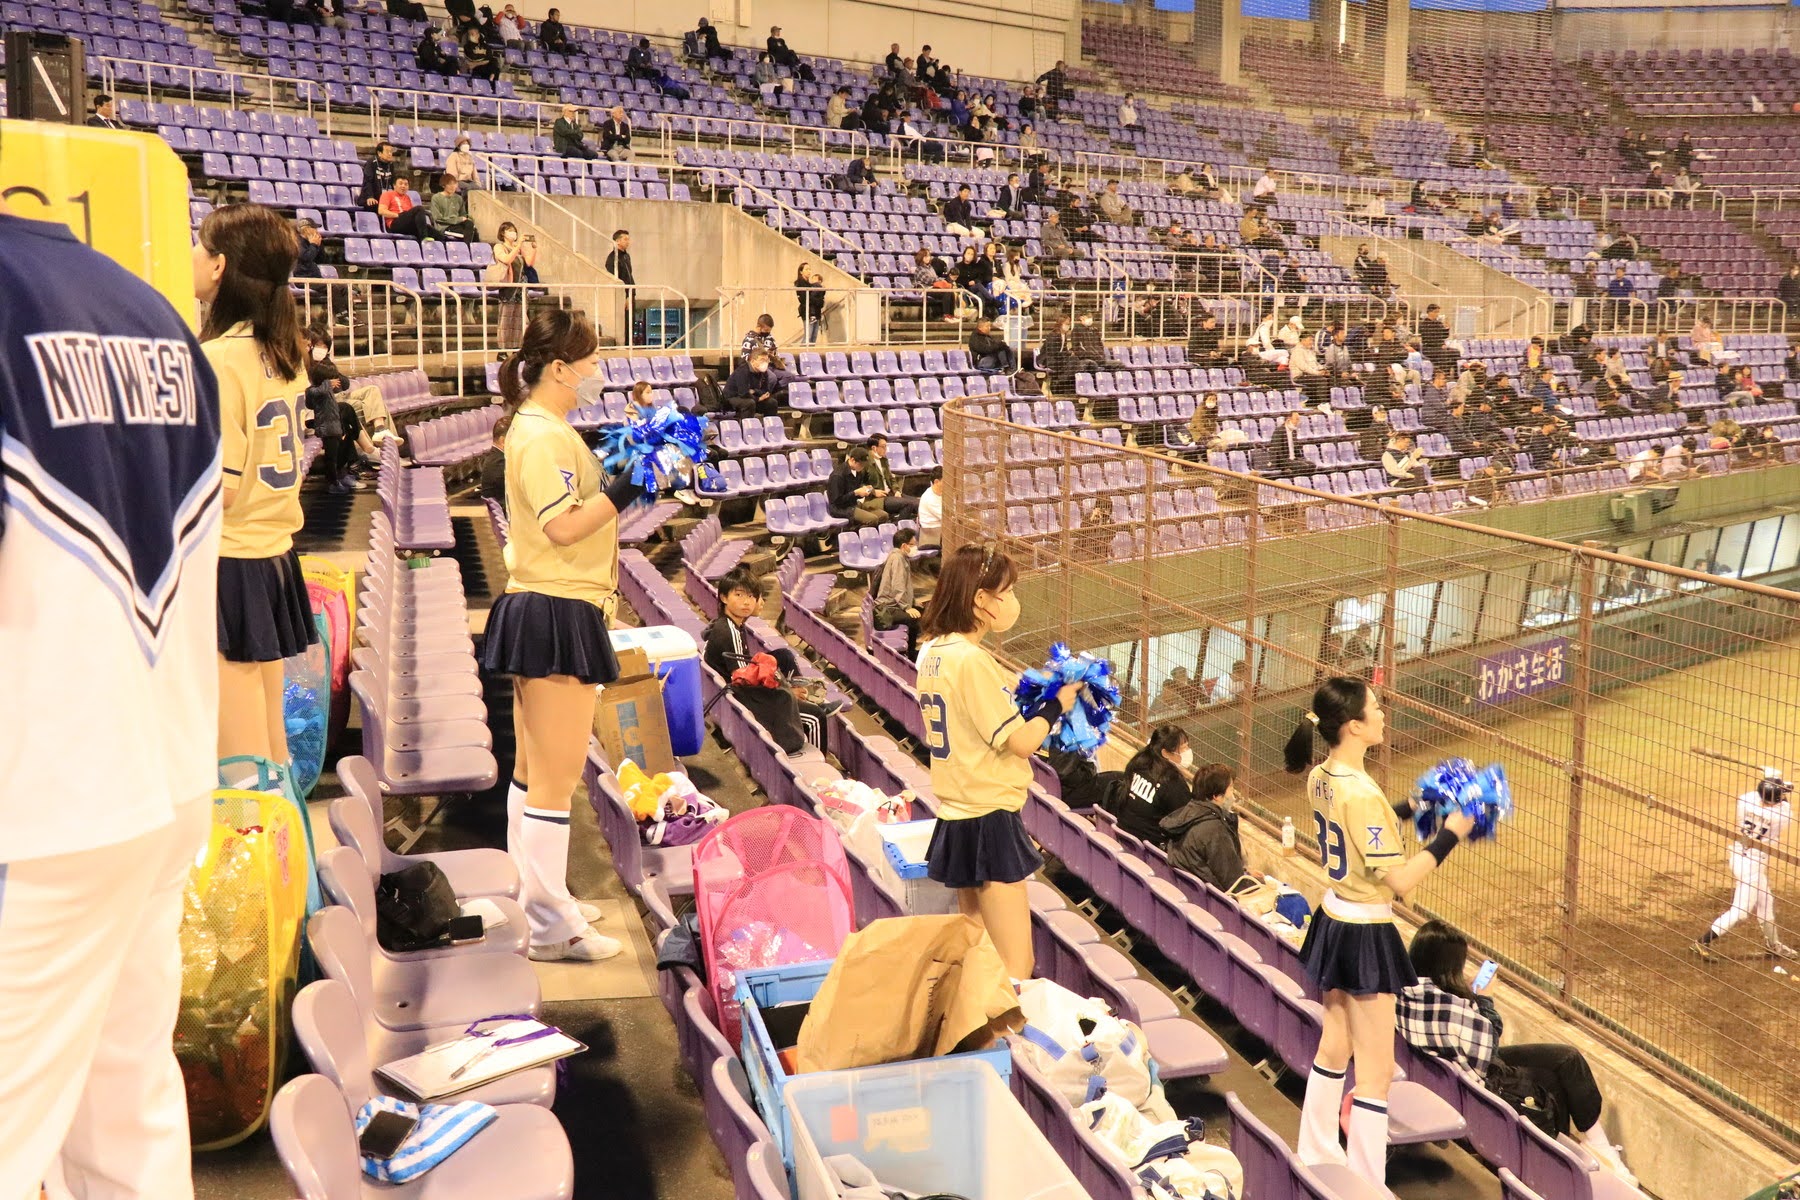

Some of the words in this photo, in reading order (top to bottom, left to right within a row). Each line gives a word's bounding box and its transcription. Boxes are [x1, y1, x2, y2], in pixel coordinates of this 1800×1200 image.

[24, 332, 116, 428] NTT
[101, 336, 198, 426] WEST
[1478, 645, 1563, 700] わかさ生活
